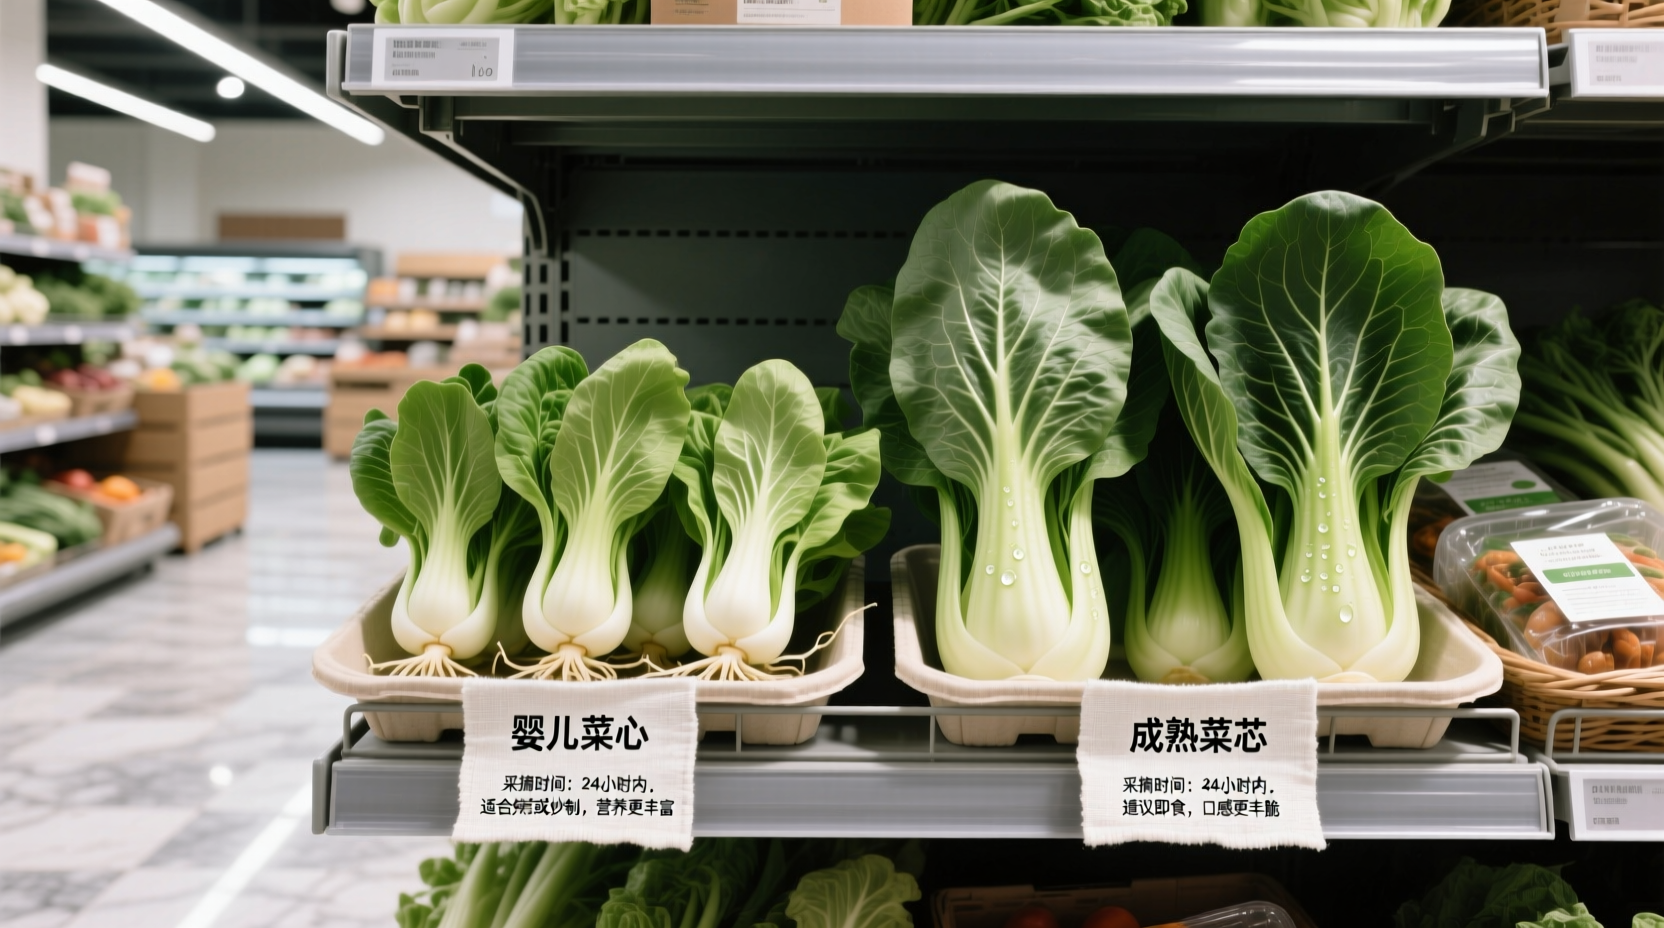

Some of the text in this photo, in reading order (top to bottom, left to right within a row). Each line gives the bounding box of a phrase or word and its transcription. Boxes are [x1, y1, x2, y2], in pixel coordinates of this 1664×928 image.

[511, 714, 649, 752] 婴儿菜心
[1129, 716, 1268, 754] 成熟菜芯
